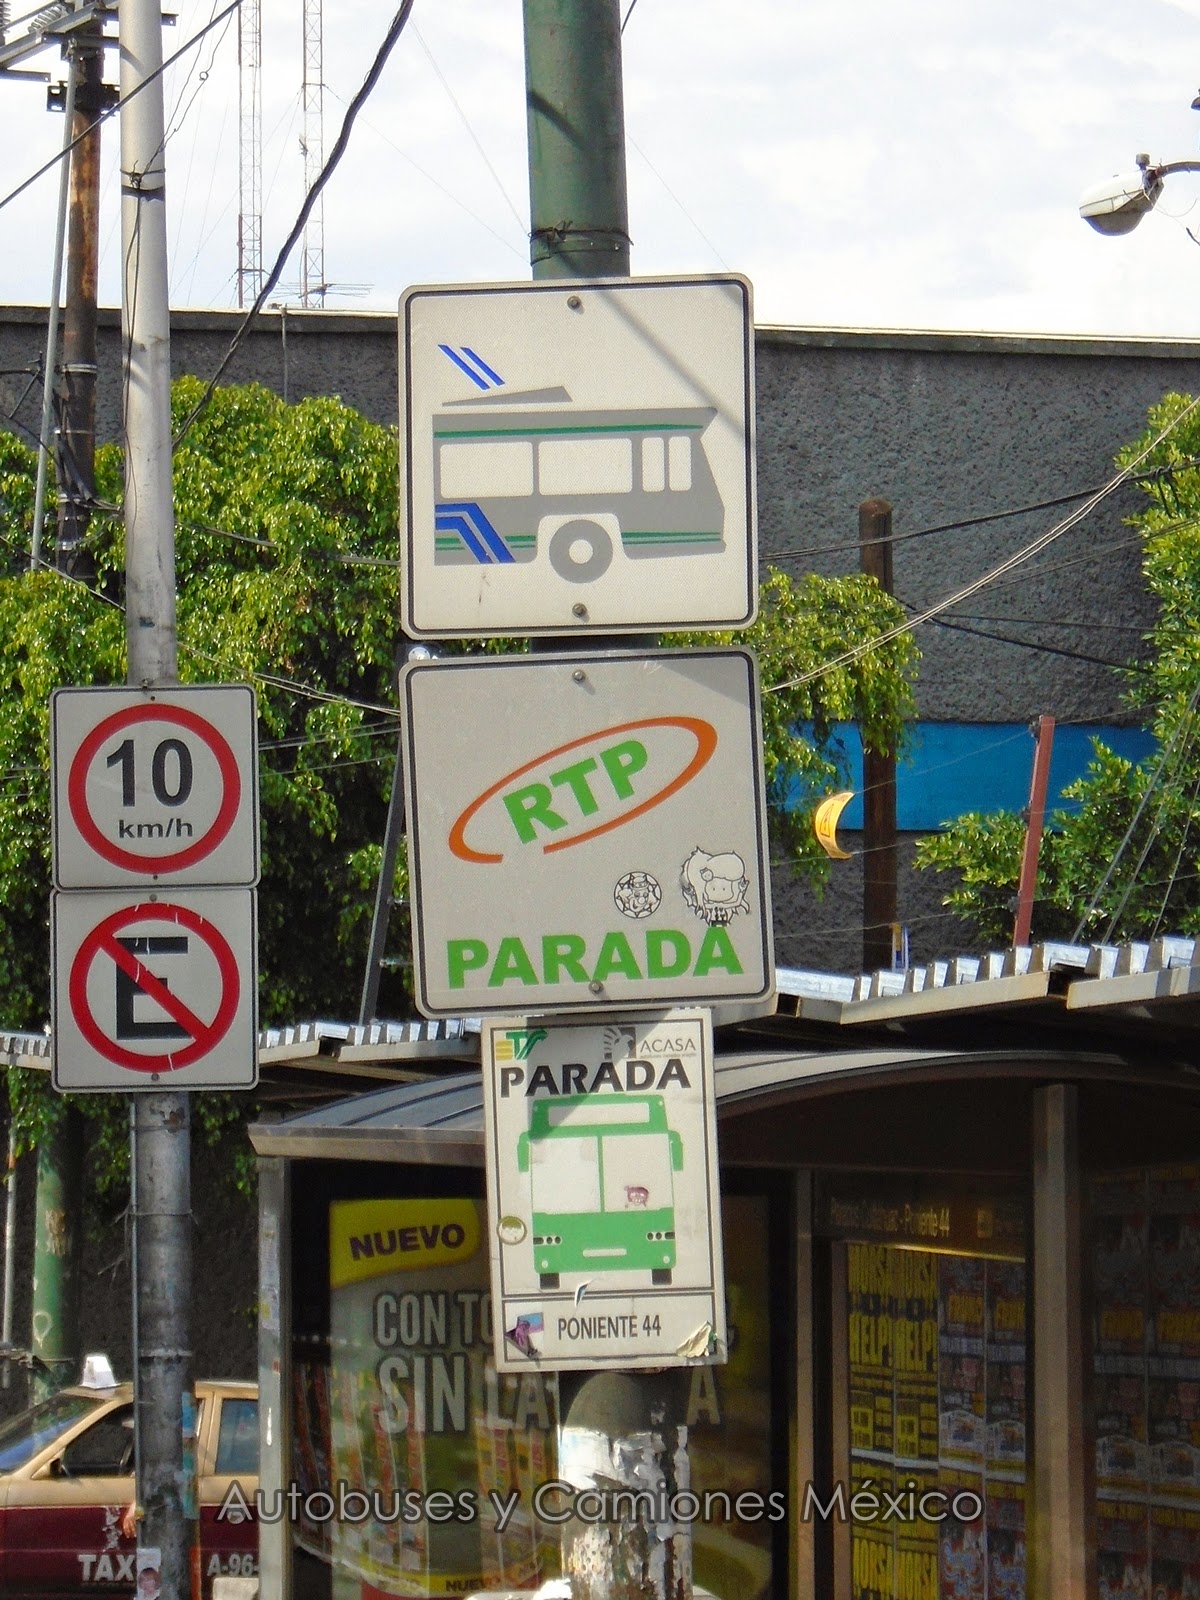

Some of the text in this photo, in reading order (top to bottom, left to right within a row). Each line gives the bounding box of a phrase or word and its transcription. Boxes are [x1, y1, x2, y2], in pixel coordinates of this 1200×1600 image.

[106, 738, 194, 807] 10
[502, 740, 648, 844] RTP
[118, 818, 194, 839] km/h
[447, 930, 744, 989] PARADA
[116, 937, 196, 1040] E
[640, 1038, 696, 1053] ACASA
[500, 1058, 691, 1098] PARADA
[349, 1223, 466, 1261] NUEVO
[374, 1293, 494, 1346] CON TO
[558, 1312, 661, 1340] PONIENTE 44
[379, 1355, 467, 1434] SIN
[78, 1554, 136, 1582] TAX
